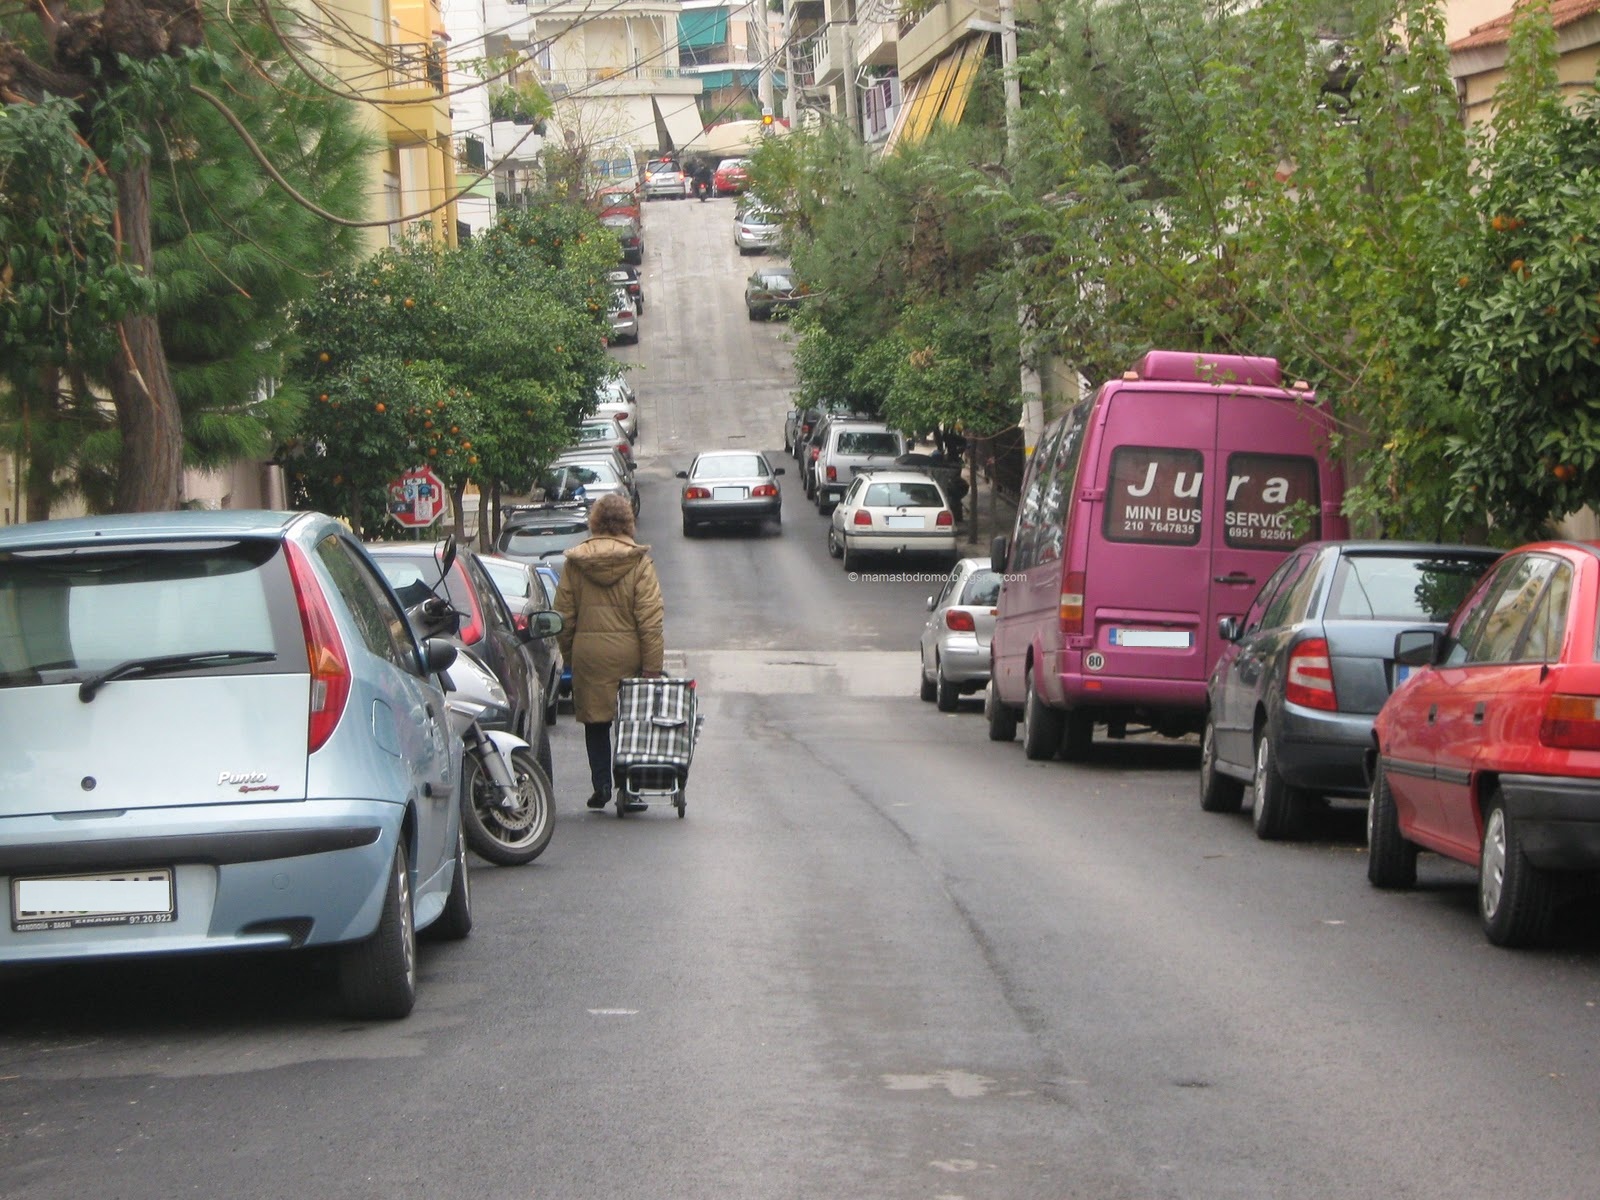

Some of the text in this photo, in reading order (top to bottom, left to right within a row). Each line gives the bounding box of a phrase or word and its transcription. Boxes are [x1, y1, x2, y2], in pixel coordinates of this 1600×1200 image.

[1127, 462, 1289, 503] Jura
[1125, 505, 1293, 529] MINI BUS SERVIC
[1124, 520, 1295, 541] 210 7647835 6951 92501
[1088, 655, 1102, 668] 80
[217, 770, 267, 786] Punto
